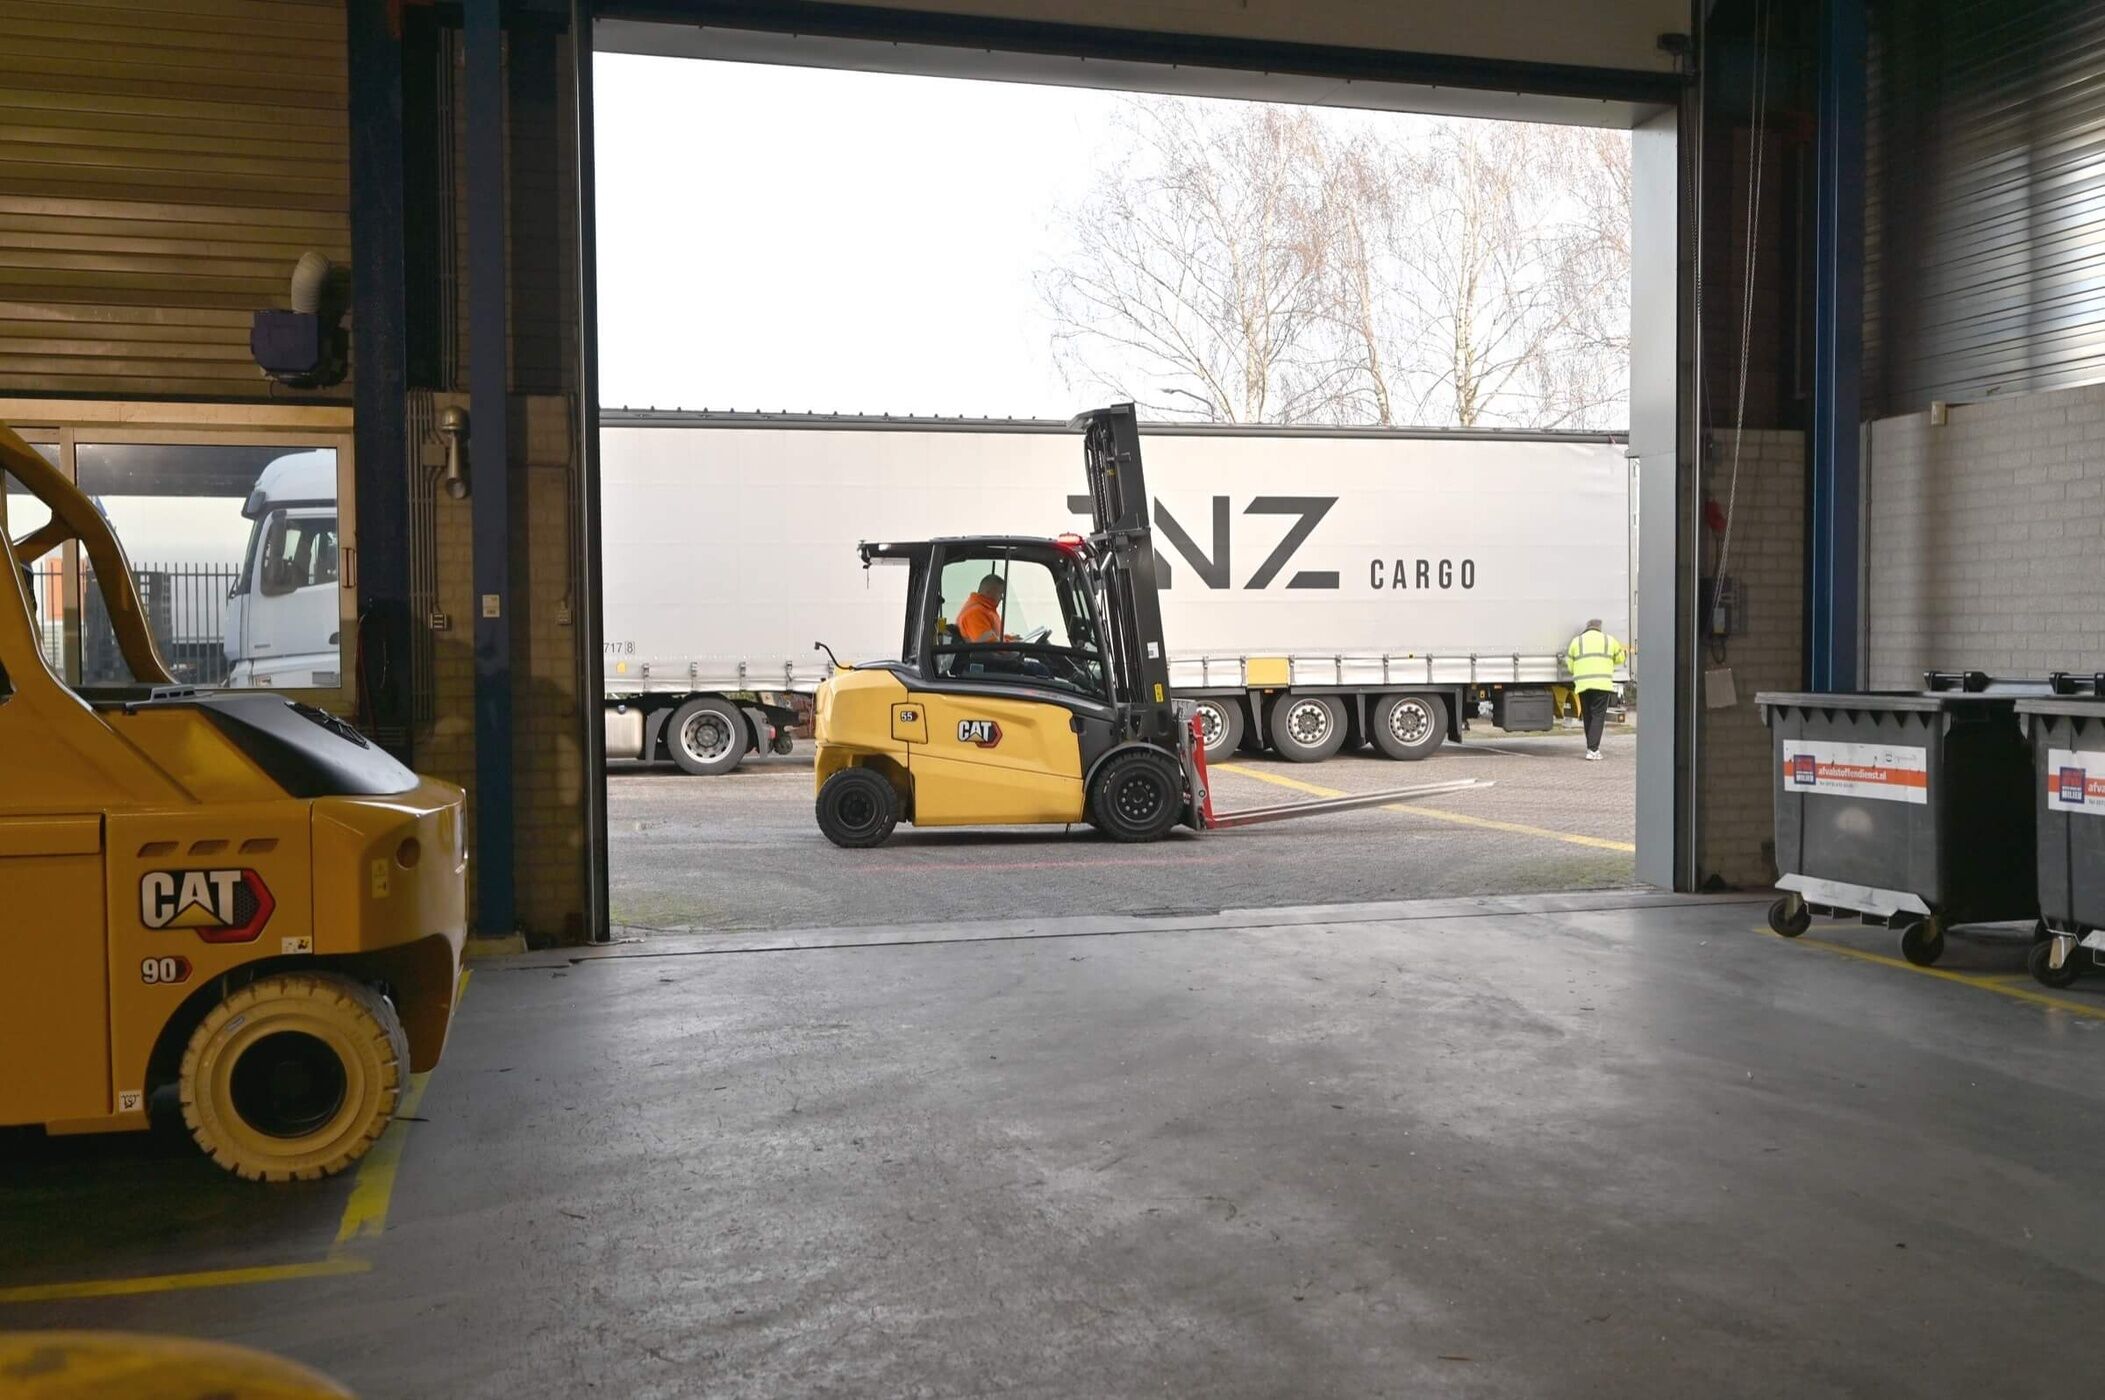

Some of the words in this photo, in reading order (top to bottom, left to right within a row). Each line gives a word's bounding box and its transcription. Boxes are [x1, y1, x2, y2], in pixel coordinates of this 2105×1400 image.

[1067, 496, 1340, 589] NZ
[1371, 559, 1475, 589] CARGO
[901, 712, 913, 721] 55
[959, 721, 992, 742] CAT
[1818, 766, 1887, 780] afvalstoffendienst.nl
[142, 870, 242, 928] CAT
[142, 958, 176, 983] 90
